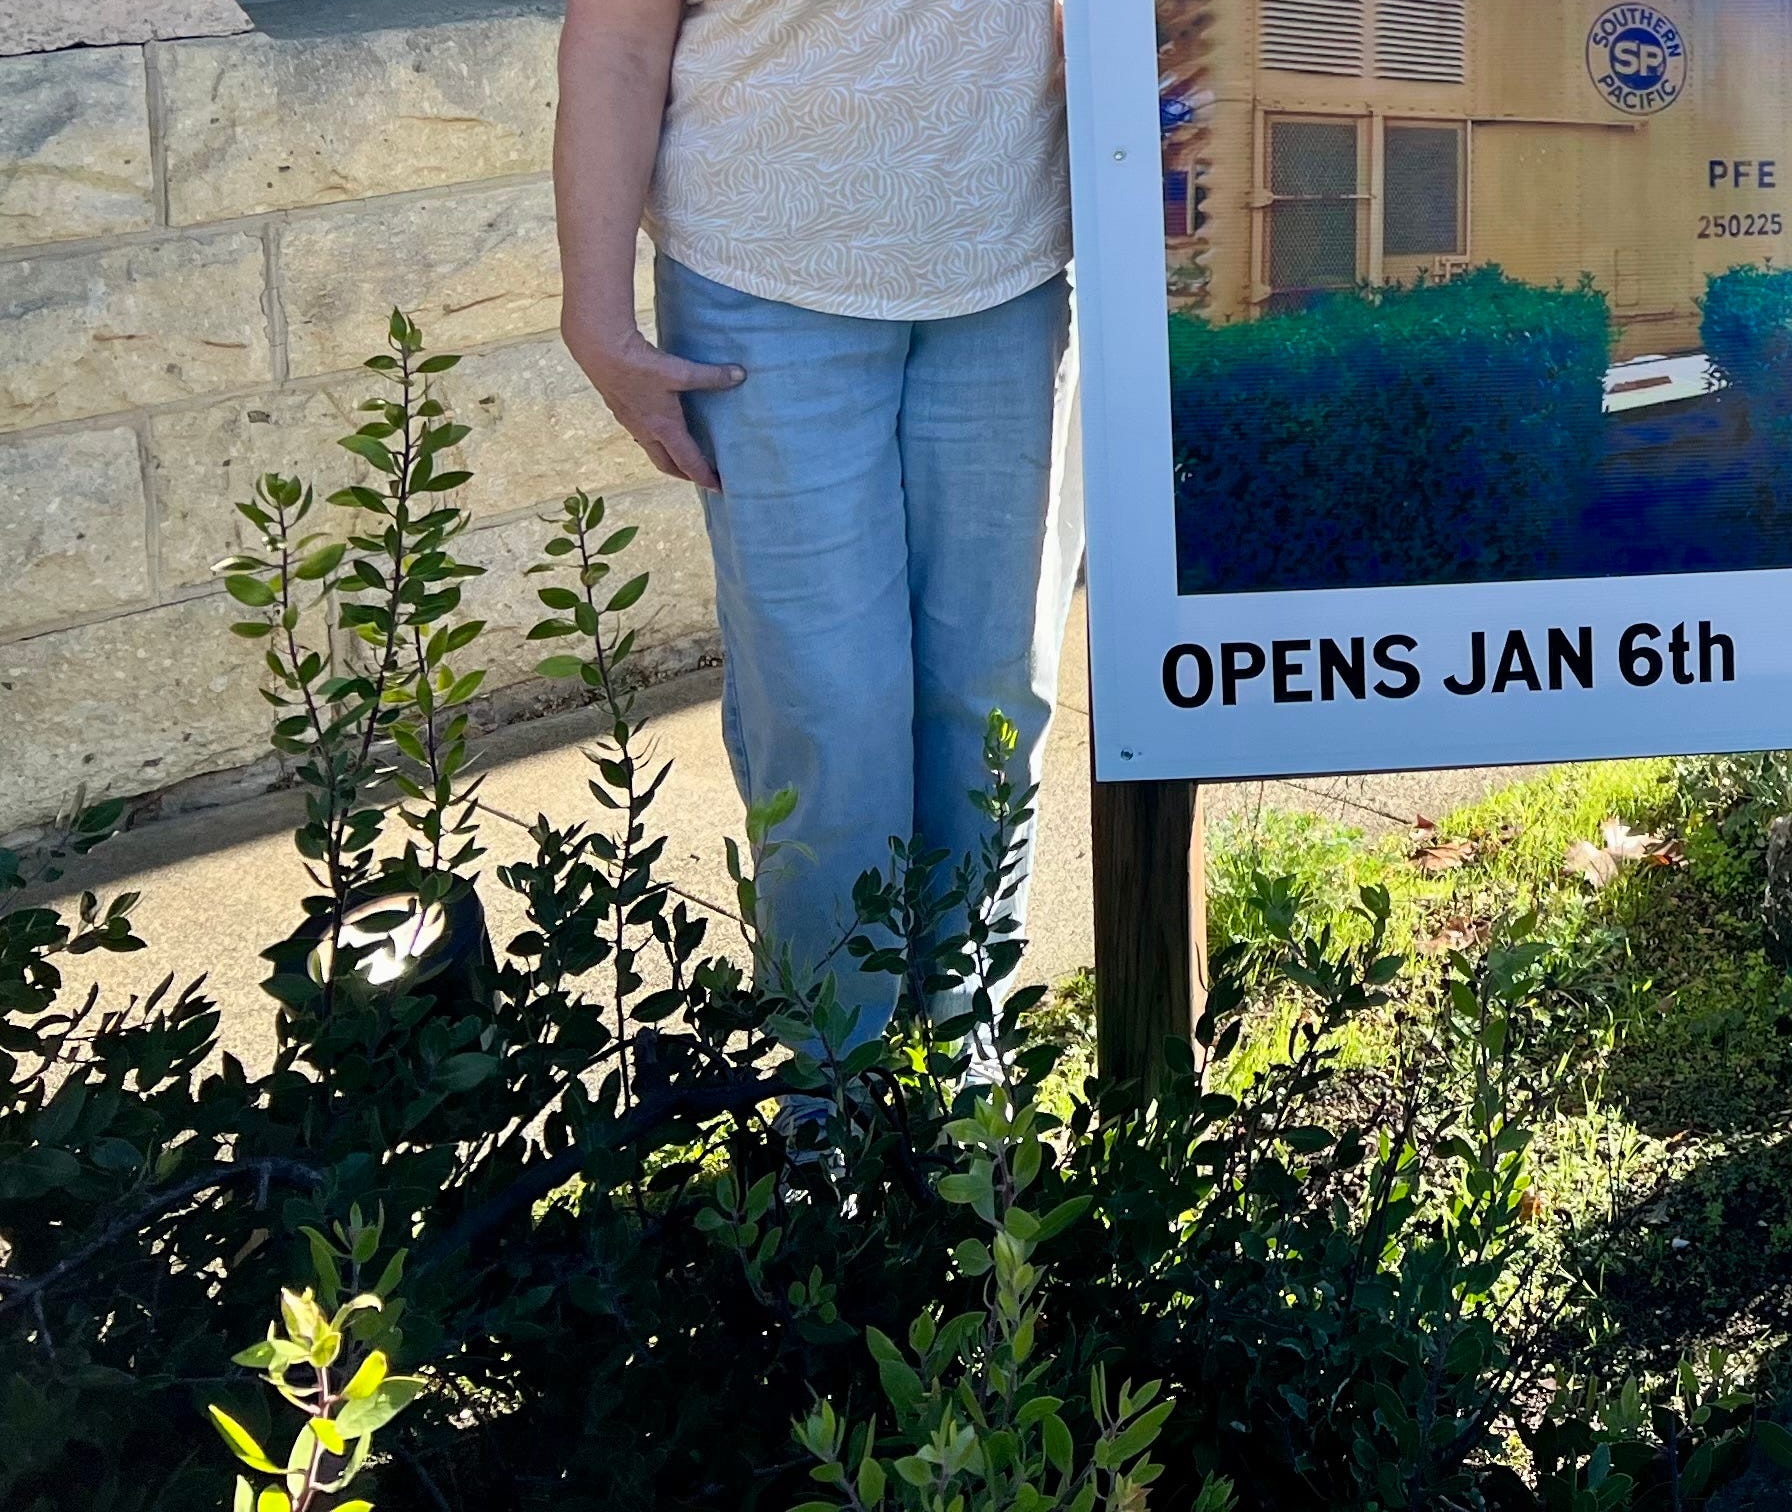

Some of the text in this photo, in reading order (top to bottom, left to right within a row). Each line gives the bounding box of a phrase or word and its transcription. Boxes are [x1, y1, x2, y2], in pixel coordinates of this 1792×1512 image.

[1592, 8, 1682, 58] SOUTHERN
[1614, 39, 1664, 76] SP
[1597, 73, 1677, 109] PACIFIC
[1708, 159, 1777, 189] PFE
[1697, 213, 1783, 239] 250225
[1163, 634, 1421, 709] OPENS
[1443, 626, 1594, 696] JAN
[1618, 620, 1735, 687] 6th
